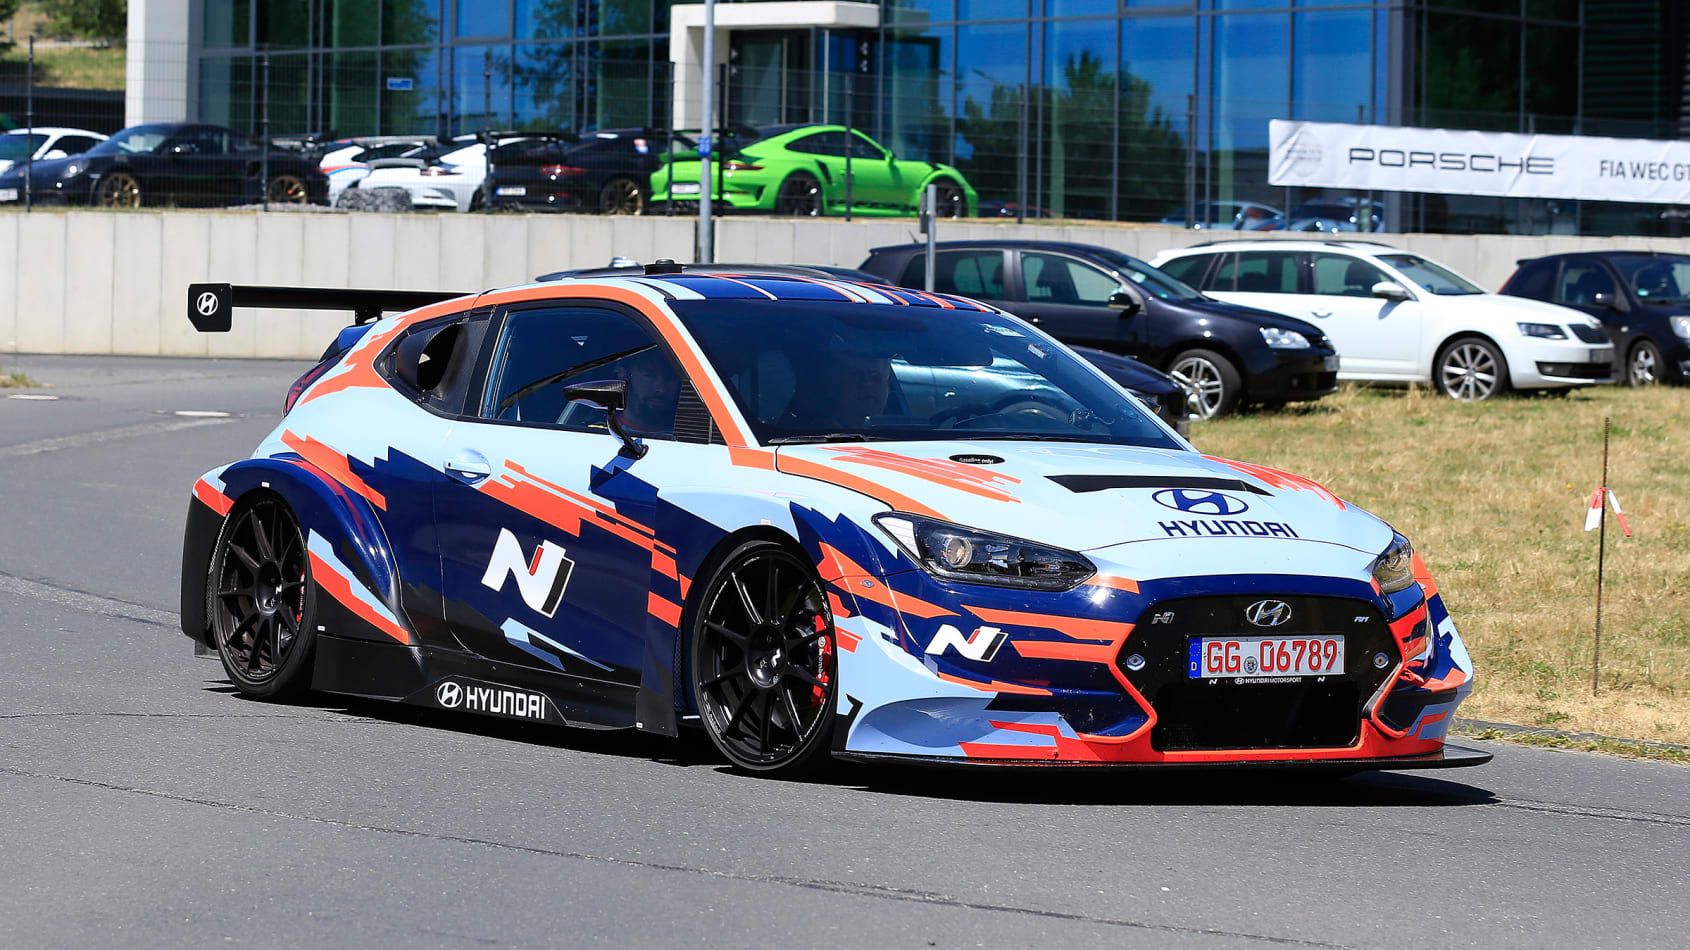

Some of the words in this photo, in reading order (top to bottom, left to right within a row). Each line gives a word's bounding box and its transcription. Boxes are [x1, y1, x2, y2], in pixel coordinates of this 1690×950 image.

[1349, 148, 1554, 175] PORSCHE
[1600, 160, 1626, 178] FIA
[1630, 161, 1669, 181] WEC
[1158, 520, 1299, 538] HYUNDAI
[1191, 662, 1198, 671] D
[1207, 641, 1241, 672] GG
[1260, 639, 1338, 672] 06789
[466, 686, 546, 720] HYUNDAI
